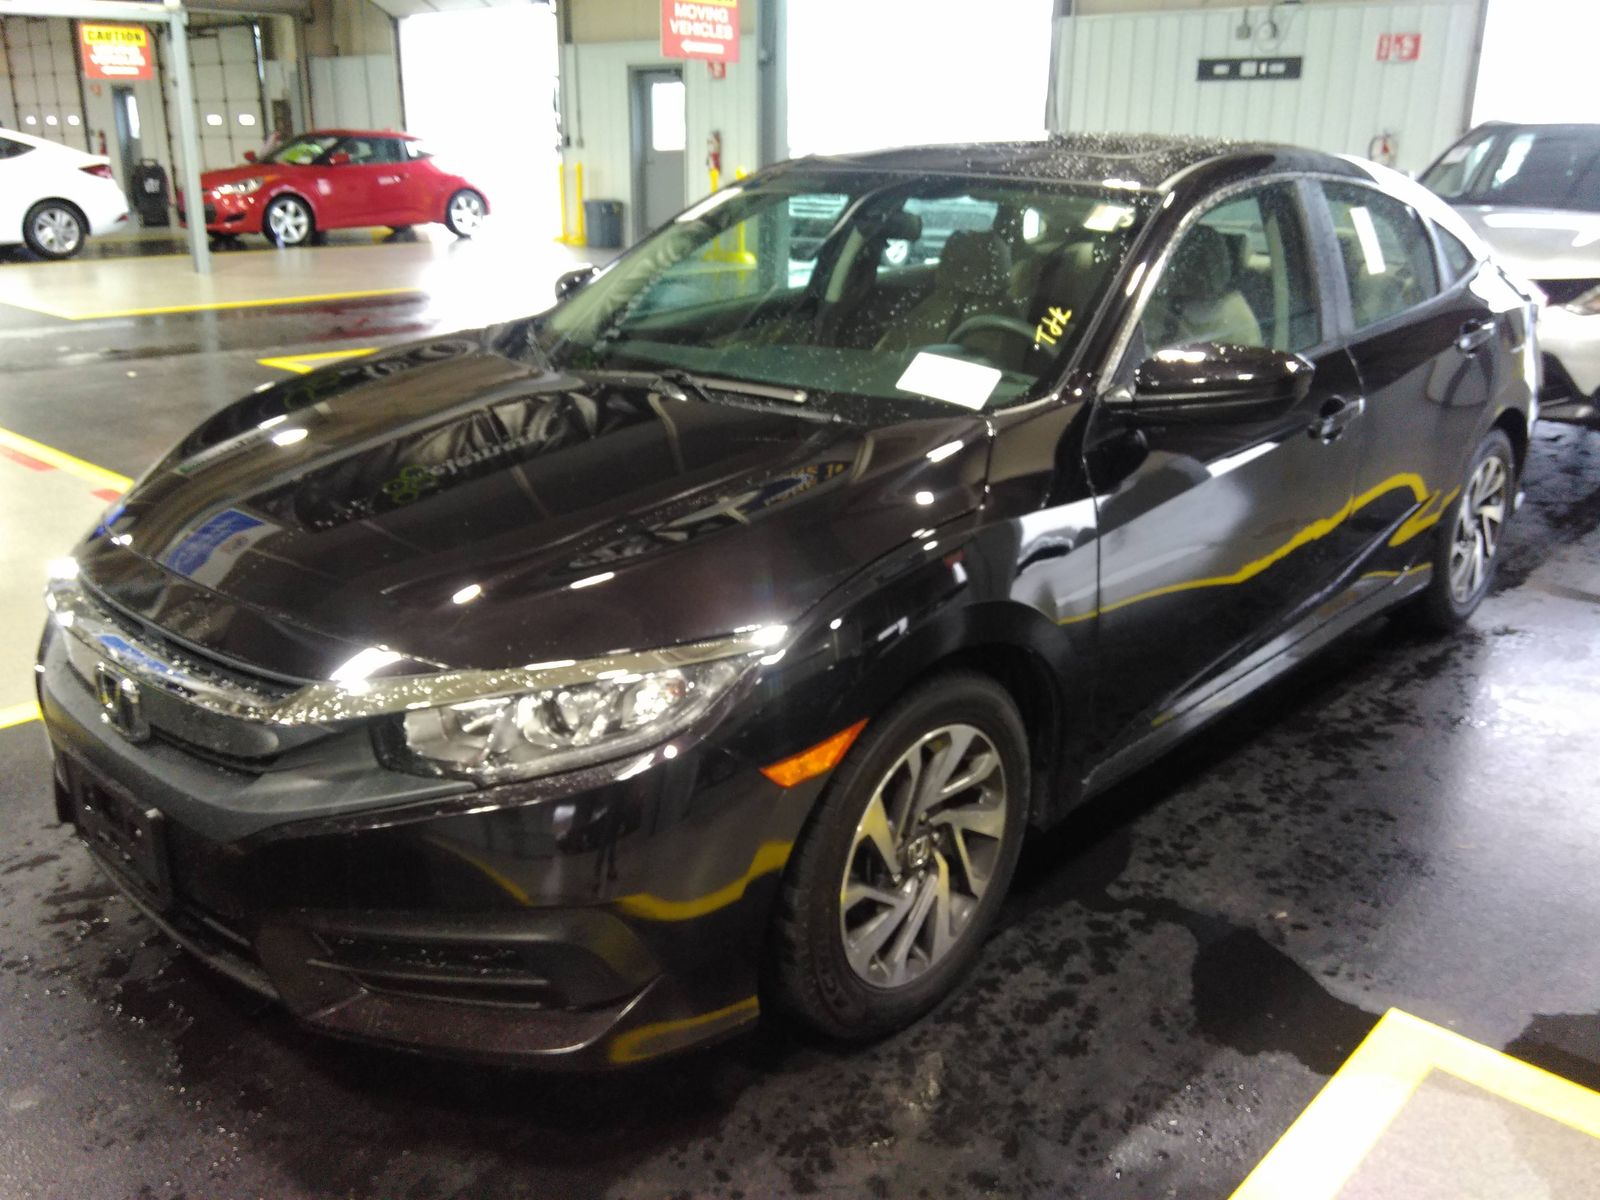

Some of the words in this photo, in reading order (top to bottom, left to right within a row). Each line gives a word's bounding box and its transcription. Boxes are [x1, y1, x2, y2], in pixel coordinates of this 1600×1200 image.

[674, 2, 729, 23] MOVING
[87, 31, 142, 41] CAUTION
[669, 17, 733, 41] VEHICLES
